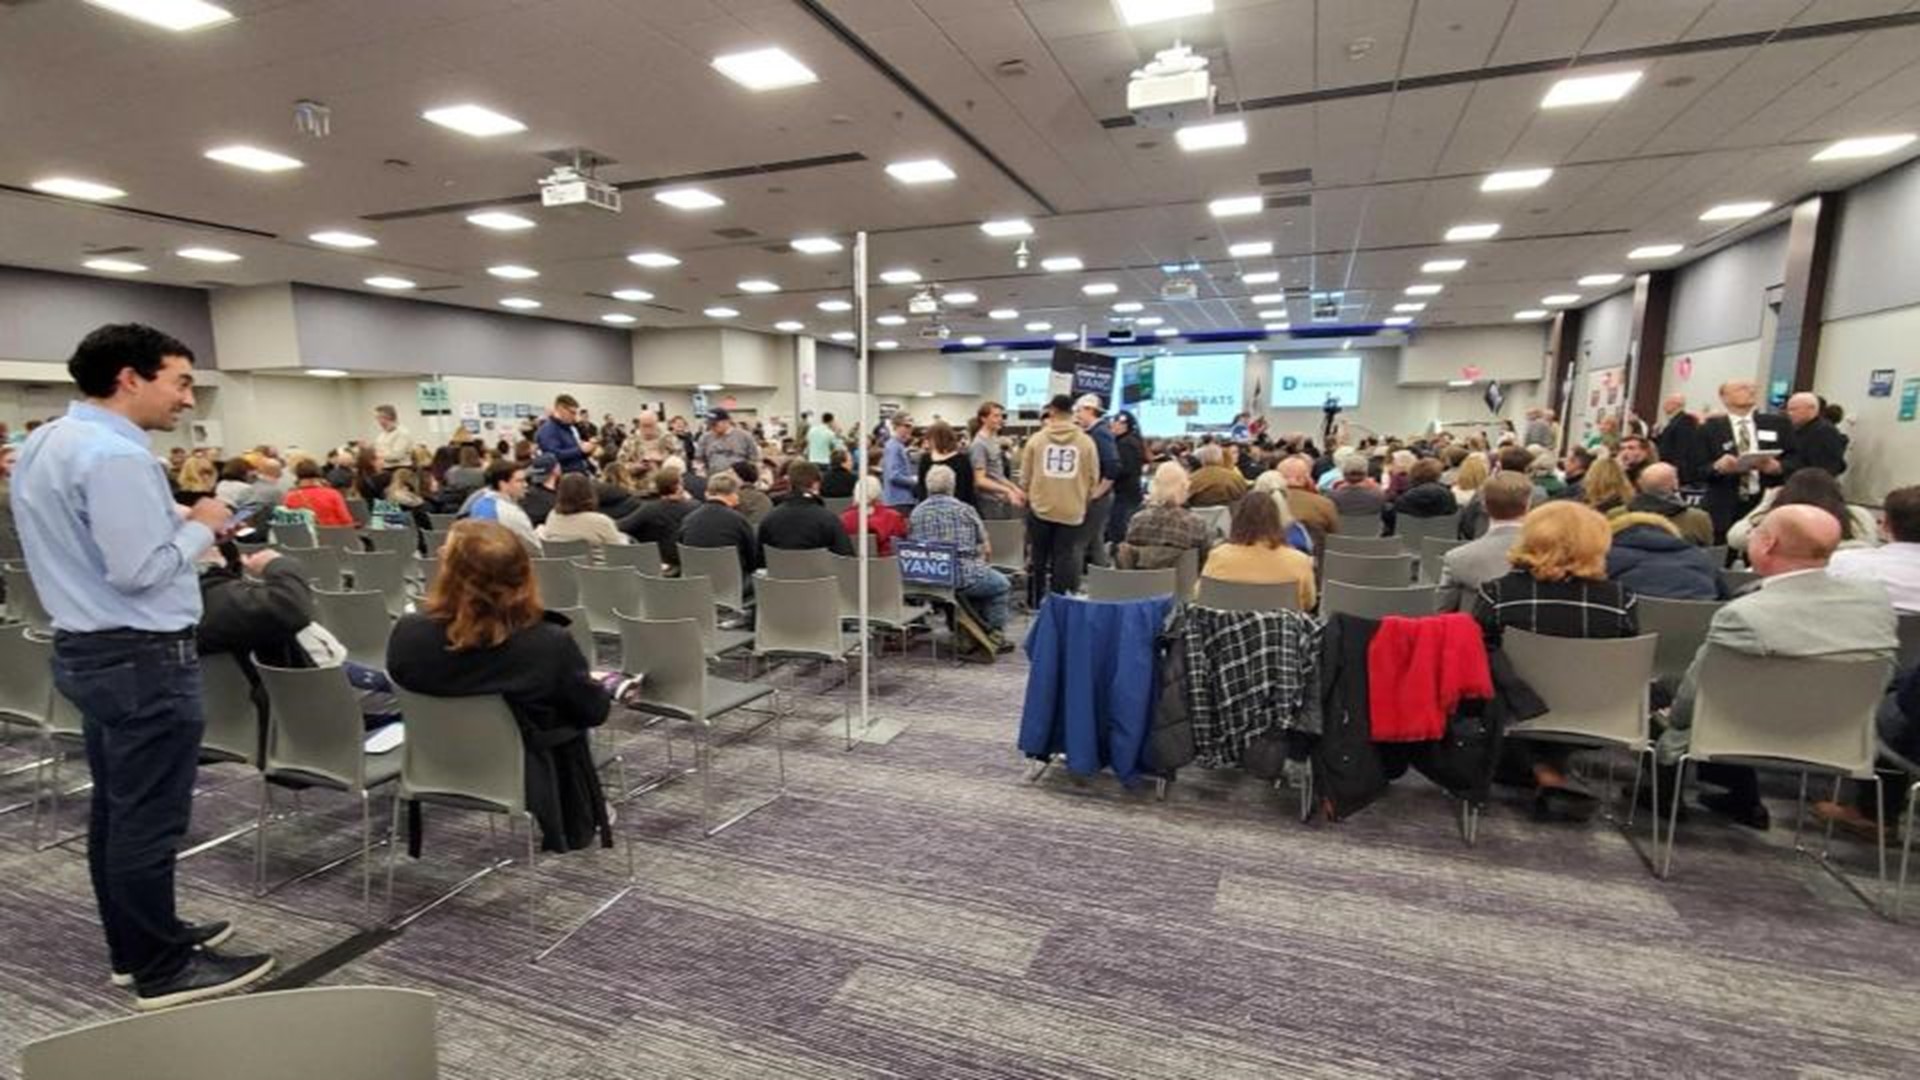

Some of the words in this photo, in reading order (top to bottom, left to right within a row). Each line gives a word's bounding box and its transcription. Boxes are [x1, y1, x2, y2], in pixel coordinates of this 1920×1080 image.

[1015, 383, 1027, 397] D
[1077, 376, 1111, 392] YANG
[1282, 376, 1297, 391] D
[900, 559, 950, 576] YANG
